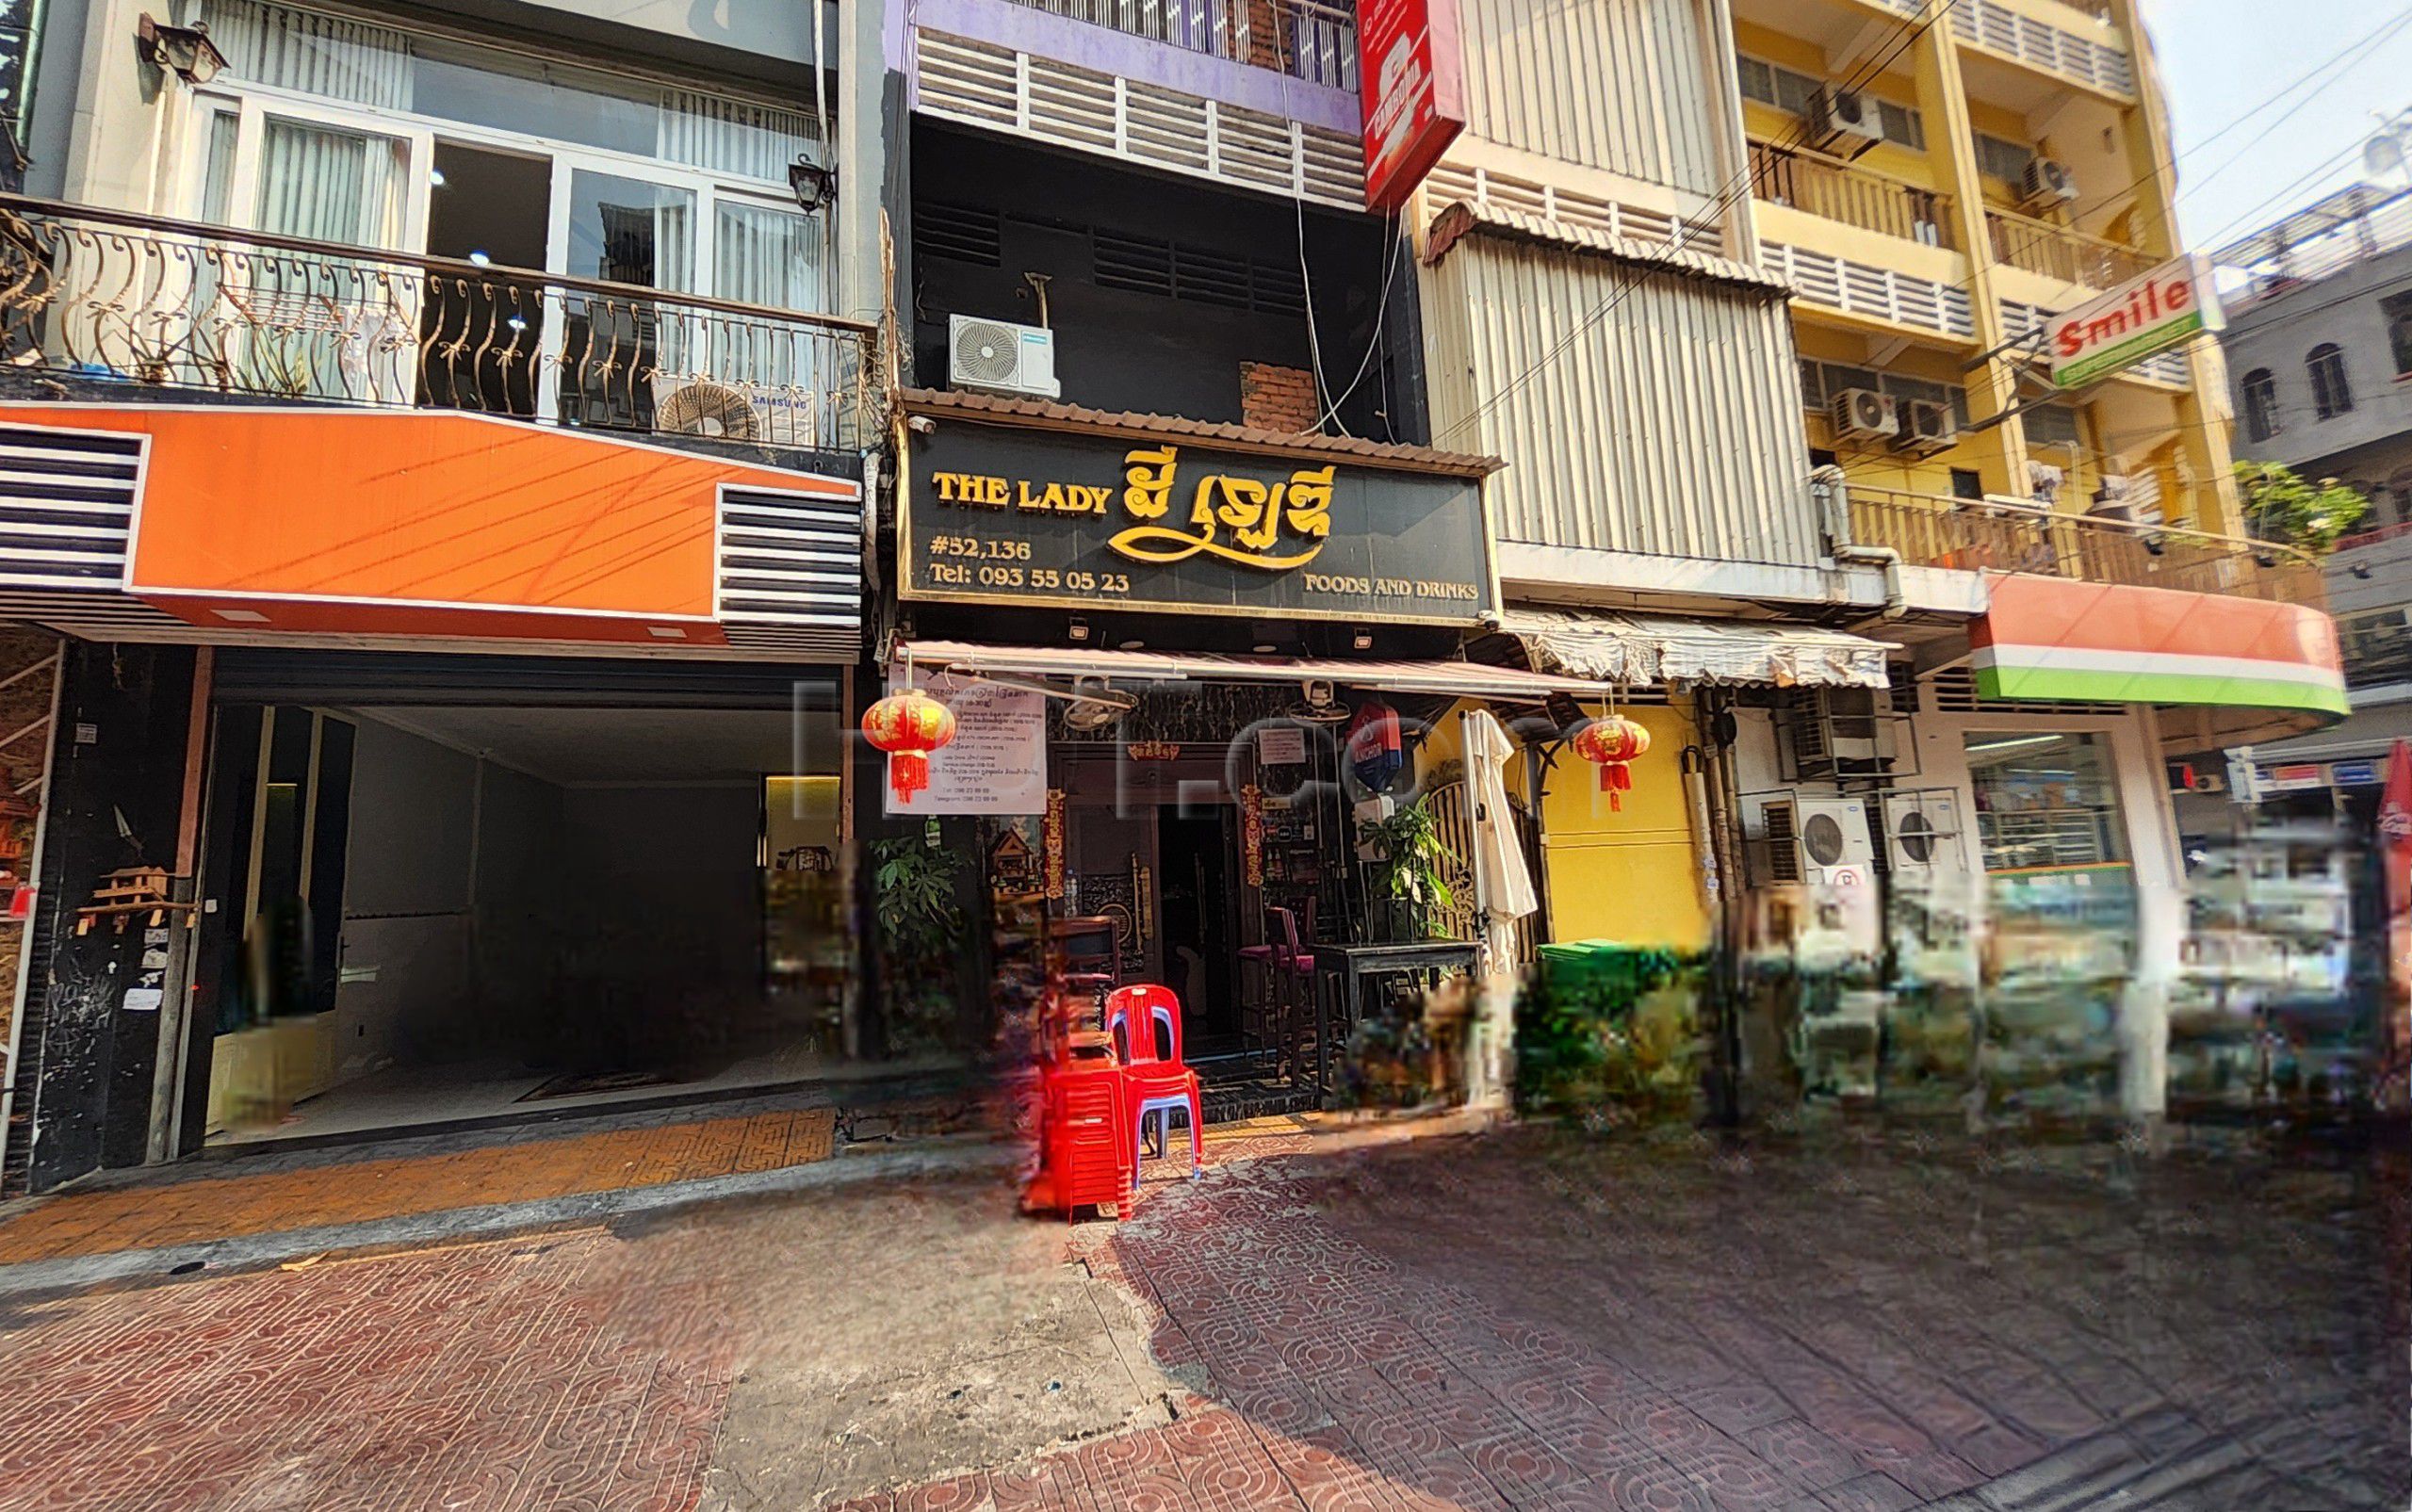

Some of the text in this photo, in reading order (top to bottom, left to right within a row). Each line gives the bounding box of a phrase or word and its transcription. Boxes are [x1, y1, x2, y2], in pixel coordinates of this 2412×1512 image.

[2058, 280, 2190, 357] Smile
[753, 396, 807, 410] SAMSUNG
[932, 472, 1113, 514] THE LADY
[930, 536, 1031, 561] #52,136
[930, 563, 1129, 592] Tel: 093 55 05 23
[1304, 574, 1478, 599] FOODS AND DRINKS
